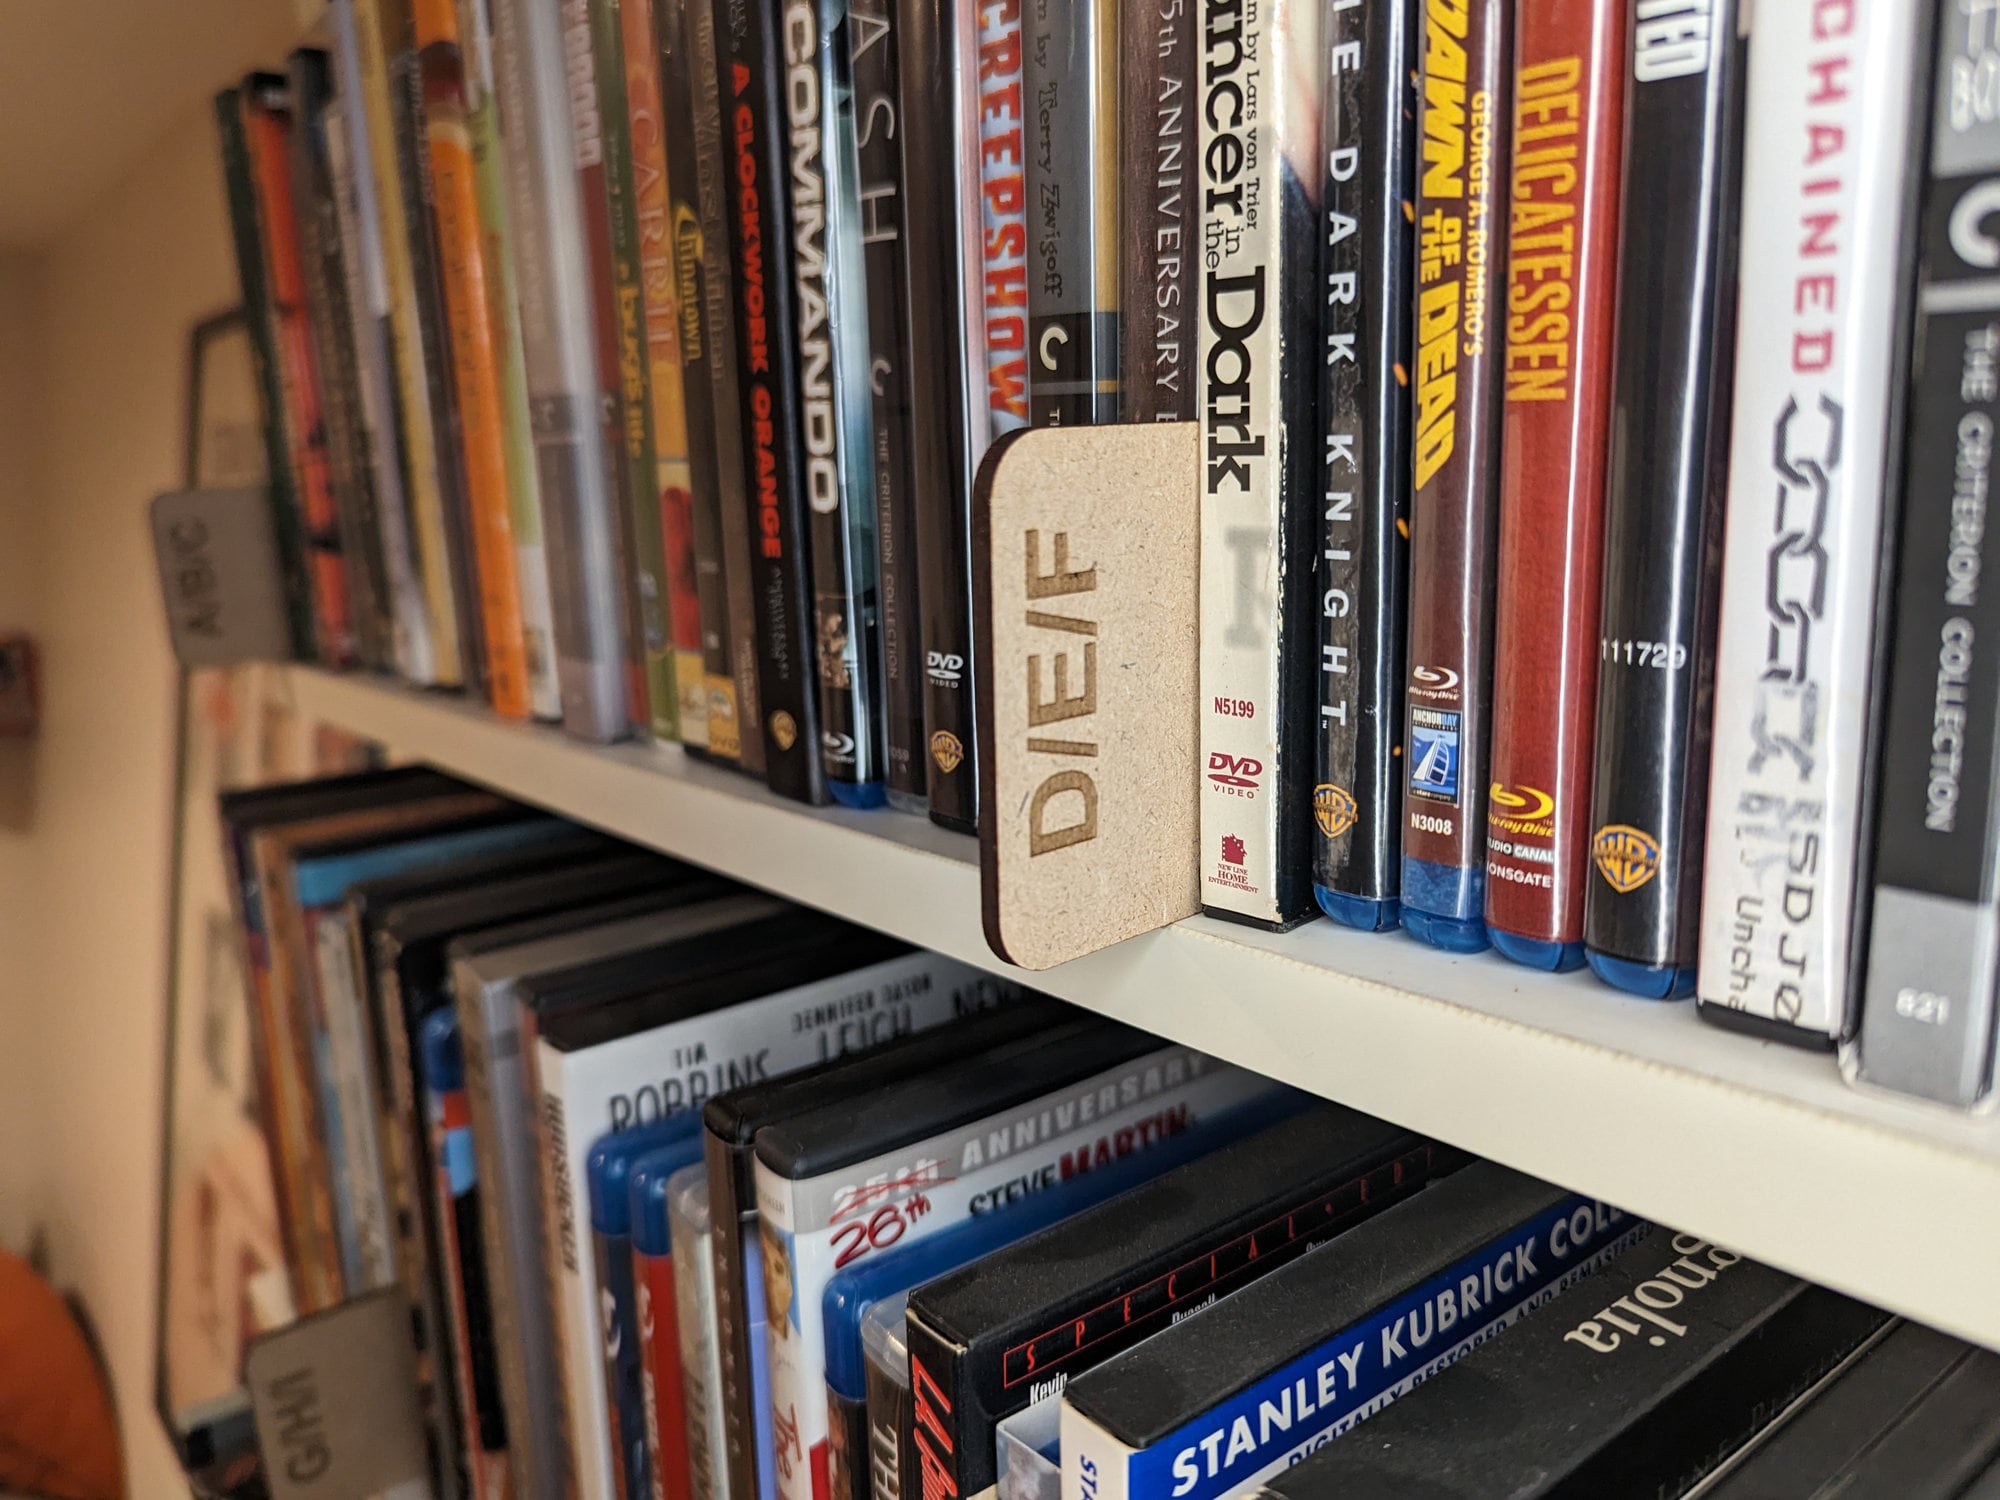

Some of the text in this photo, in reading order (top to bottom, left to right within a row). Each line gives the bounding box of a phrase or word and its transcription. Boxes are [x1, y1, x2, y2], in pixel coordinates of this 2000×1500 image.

[731, 63, 750, 97] A
[1243, 31, 1259, 63] by
[1246, 70, 1260, 121] Lars
[1246, 127, 1257, 171] von
[734, 104, 769, 375] CLOCKWORK
[975, 0, 1029, 418] CREEPSHOW
[1156, 76, 1183, 393] ANNIVERSARY
[1205, 218, 1220, 271] the
[1225, 224, 1245, 258] in
[1246, 177, 1260, 230] Trier
[1414, 0, 1469, 492] DAWN OF THE DEAD
[1463, 89, 1492, 357] GEORGE A. ROMERO'S
[1507, 55, 1582, 403] DELICATESSEN
[785, 4, 839, 514] COMMANDO
[1326, 146, 1358, 366] DARK
[1205, 264, 1266, 496] Dark
[752, 385, 782, 559] ORANGE
[1943, 410, 1995, 606] CRITERION
[880, 471, 894, 565] CRITERION
[1321, 434, 1355, 727] KNIGHT
[884, 572, 898, 680] COLLECTION
[927, 651, 964, 671] DVD
[1214, 696, 1255, 719] N5199
[1925, 616, 1976, 833] COLLECTION
[1208, 751, 1263, 777] DVD
[1213, 784, 1255, 799] VIDEO
[1410, 811, 1453, 836] N3008
[1513, 844, 1556, 863] CANAL
[1207, 876, 1259, 894] ENTERTAINMENT
[1217, 863, 1249, 876] NEW LINE
[1217, 870, 1249, 886] HOME
[960, 1052, 1201, 1173] ANNIVERSARY
[829, 1191, 933, 1270] 26th
[1170, 1340, 1366, 1499] STANLEY
[1381, 1235, 1538, 1369] KUBRICK
